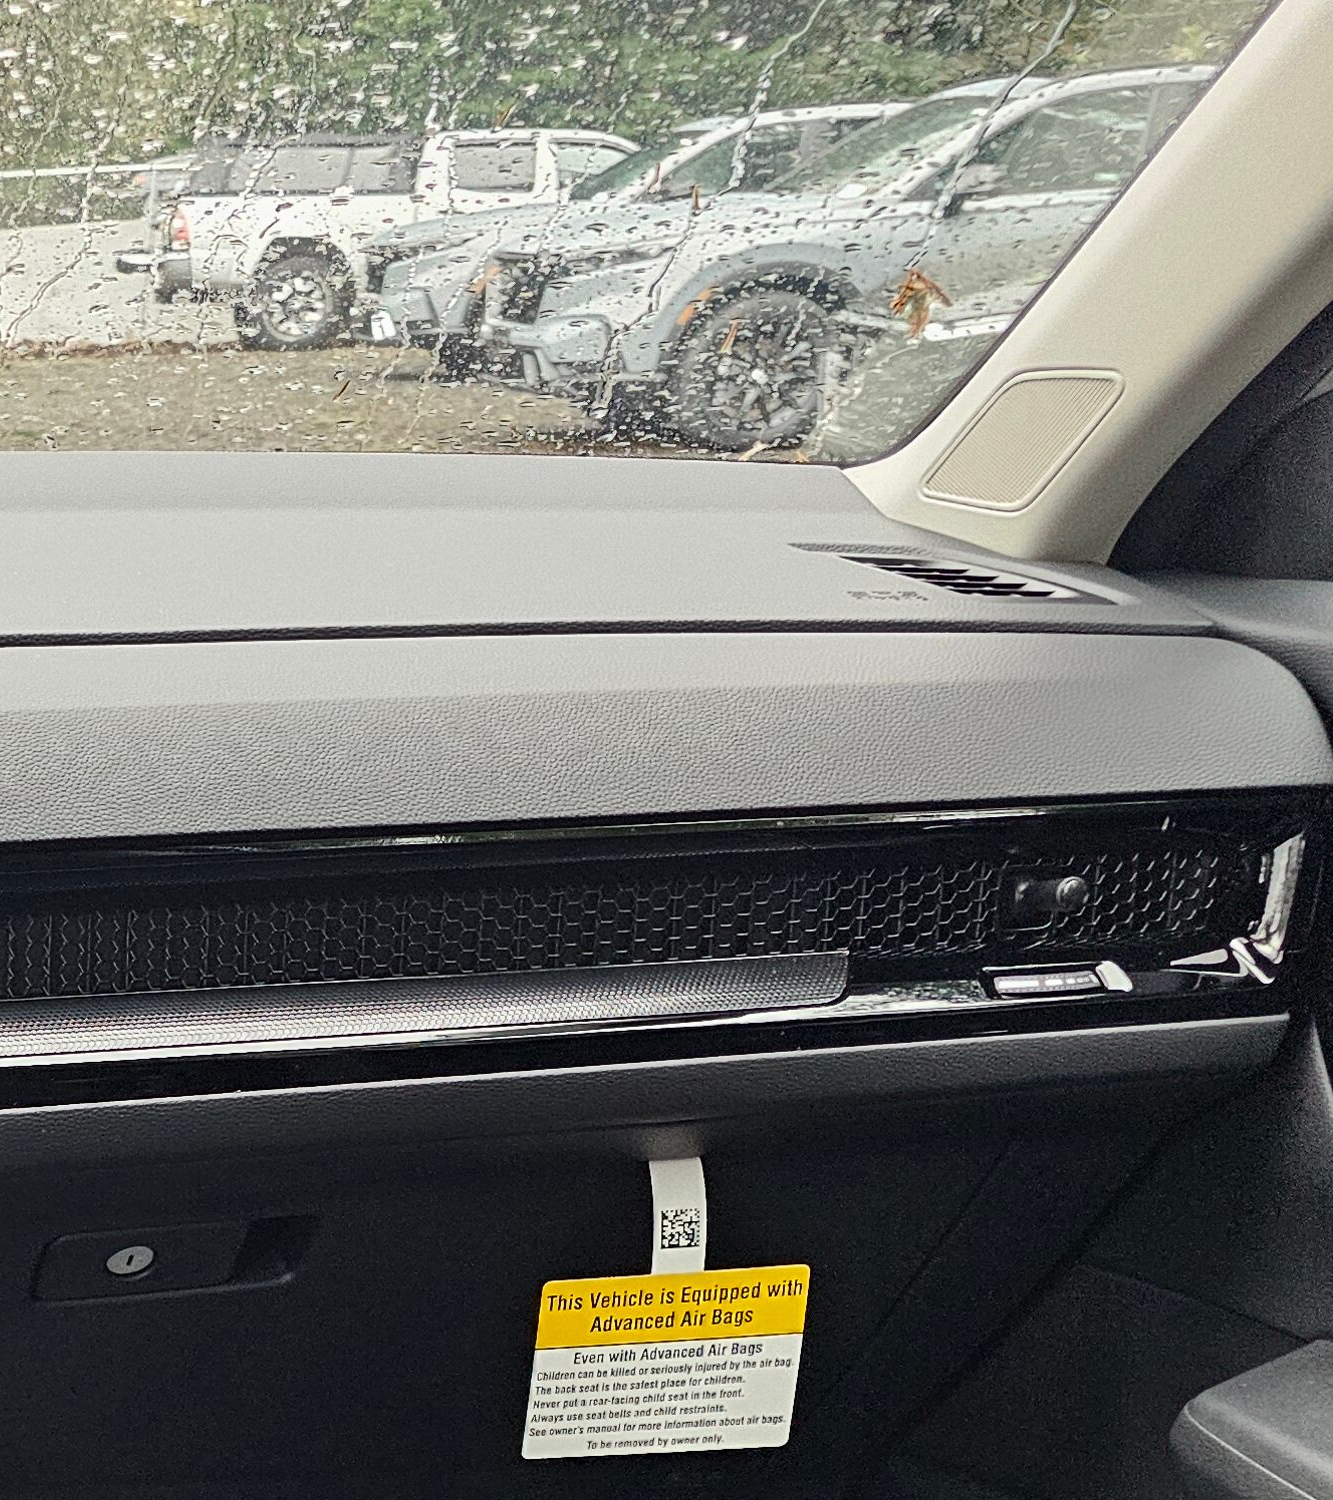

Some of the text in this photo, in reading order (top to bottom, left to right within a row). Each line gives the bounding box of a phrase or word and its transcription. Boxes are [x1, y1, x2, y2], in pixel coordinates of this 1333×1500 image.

[547, 1279, 803, 1312] This Vehicle is Equipped with
[590, 1308, 754, 1333] Advanced Air Bags
[573, 1342, 763, 1365] Even with Advanced Air Bags
[537, 1357, 794, 1382] Children can be killed or seriously injured by the air bag.
[535, 1375, 746, 1395] The back seat is the safest place for children.
[533, 1400, 560, 1410] Never
[563, 1399, 578, 1409] put
[589, 1395, 640, 1407] rear-facing
[642, 1393, 666, 1403] child
[667, 1392, 688, 1401] seat
[691, 1391, 700, 1400] in
[702, 1390, 717, 1400] the
[719, 1388, 745, 1398] front.
[529, 1414, 786, 1437] See owner's manual for more information about air bags.
[531, 1404, 727, 1424] Always use seat belts and child restraints.
[587, 1433, 724, 1450] To be removed by owner only.
